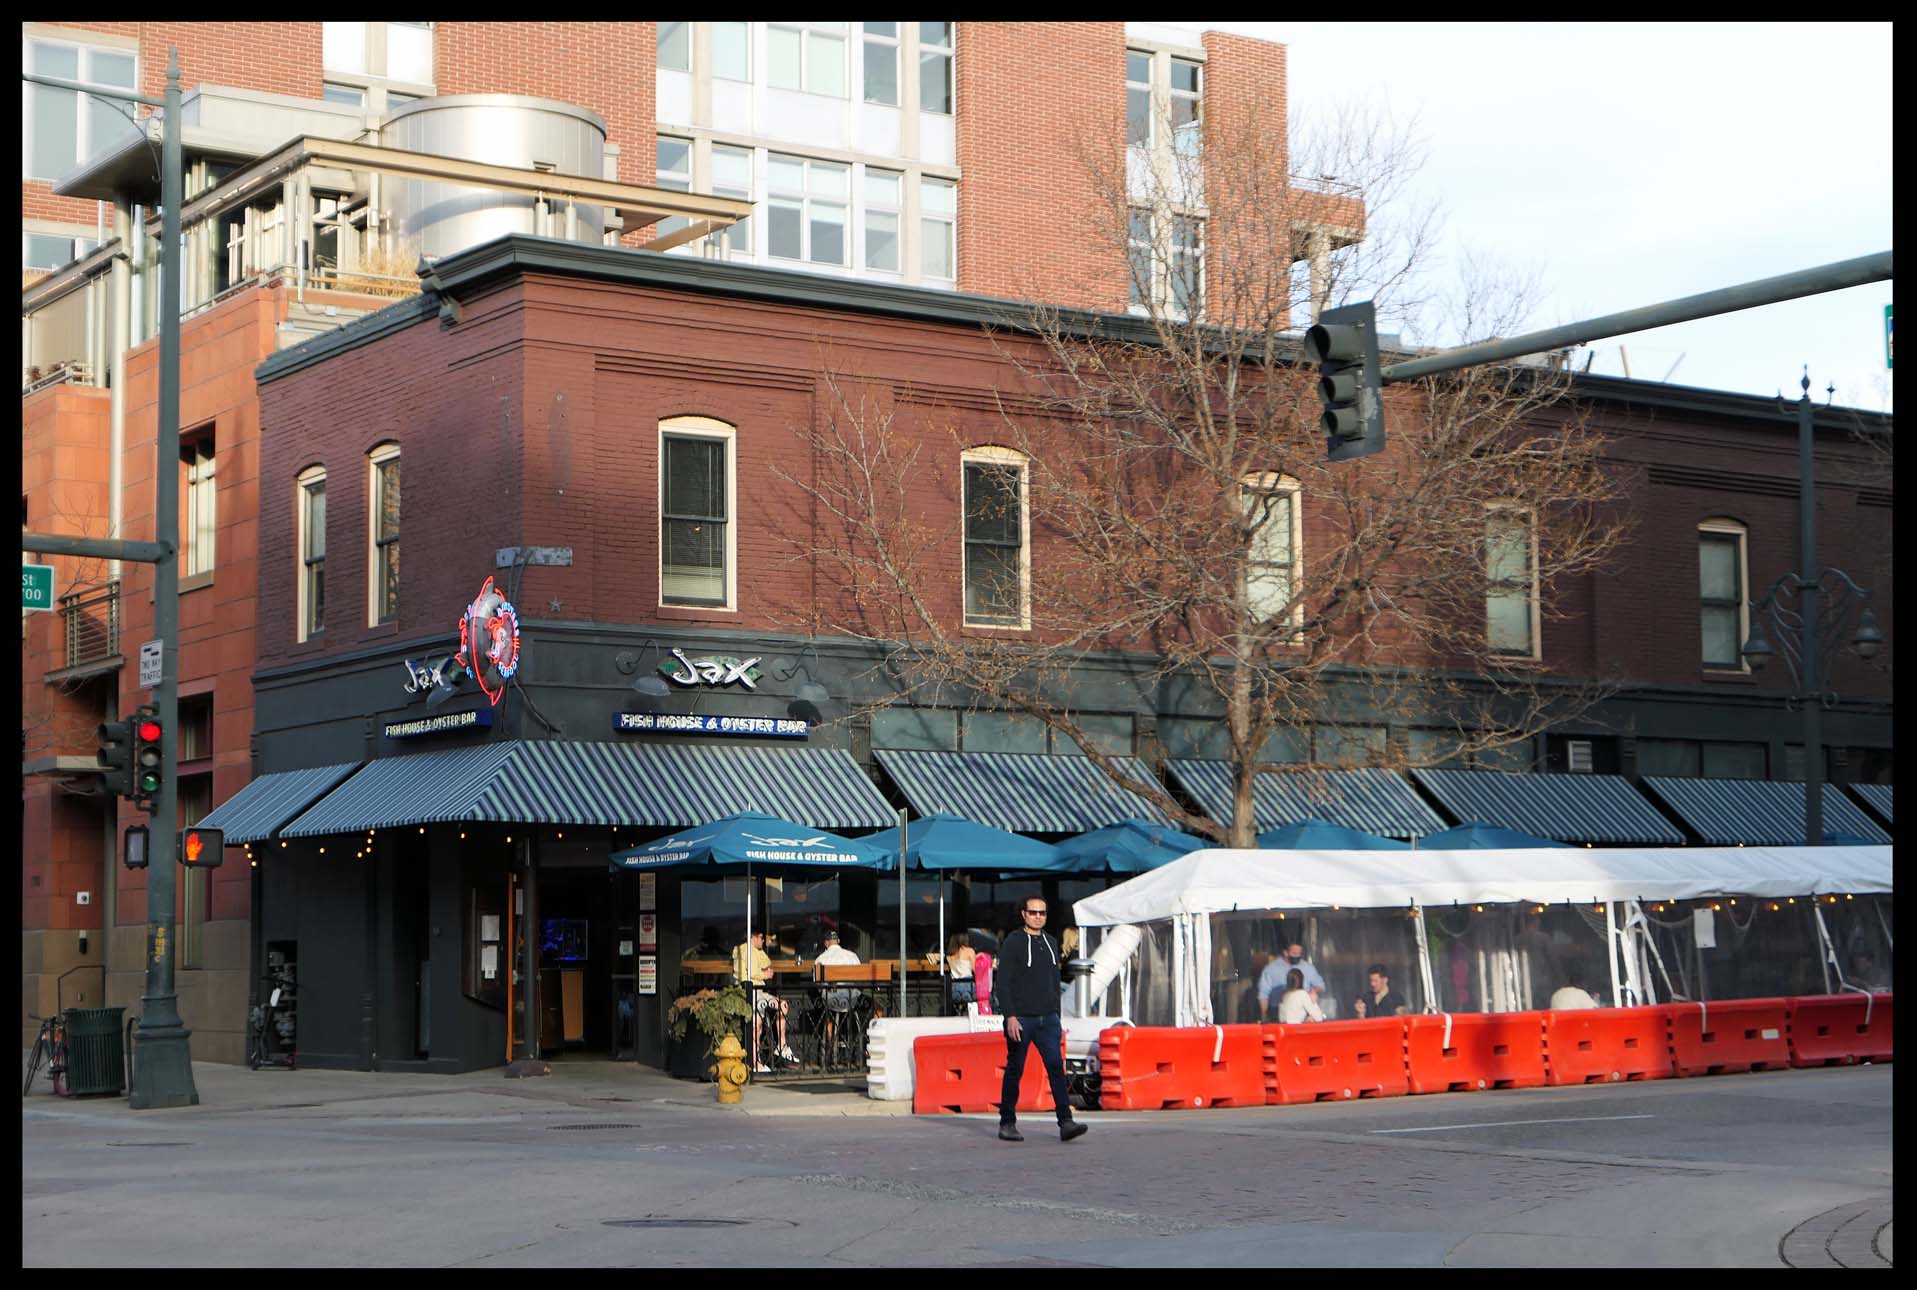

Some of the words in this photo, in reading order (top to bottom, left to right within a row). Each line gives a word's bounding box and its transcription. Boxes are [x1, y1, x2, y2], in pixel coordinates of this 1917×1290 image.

[22, 574, 33, 586] St
[22, 588, 42, 600] 00
[385, 724, 401, 736] FISH
[402, 720, 424, 735] HOUSE
[425, 719, 431, 731] &
[433, 714, 460, 729] OYSTER
[461, 711, 477, 725] BAR
[620, 713, 653, 727] FISH
[656, 714, 703, 729] HOUSE
[706, 717, 718, 730] &
[721, 717, 774, 732] OYSTER
[777, 719, 807, 734] BAR
[639, 854, 656, 864] HOUSE
[660, 852, 679, 862] OYSTER
[745, 850, 766, 859] FISH
[767, 851, 796, 860] HOUSE
[797, 852, 804, 861] &
[804, 852, 838, 862] OYSTER
[839, 853, 858, 862] BAR
